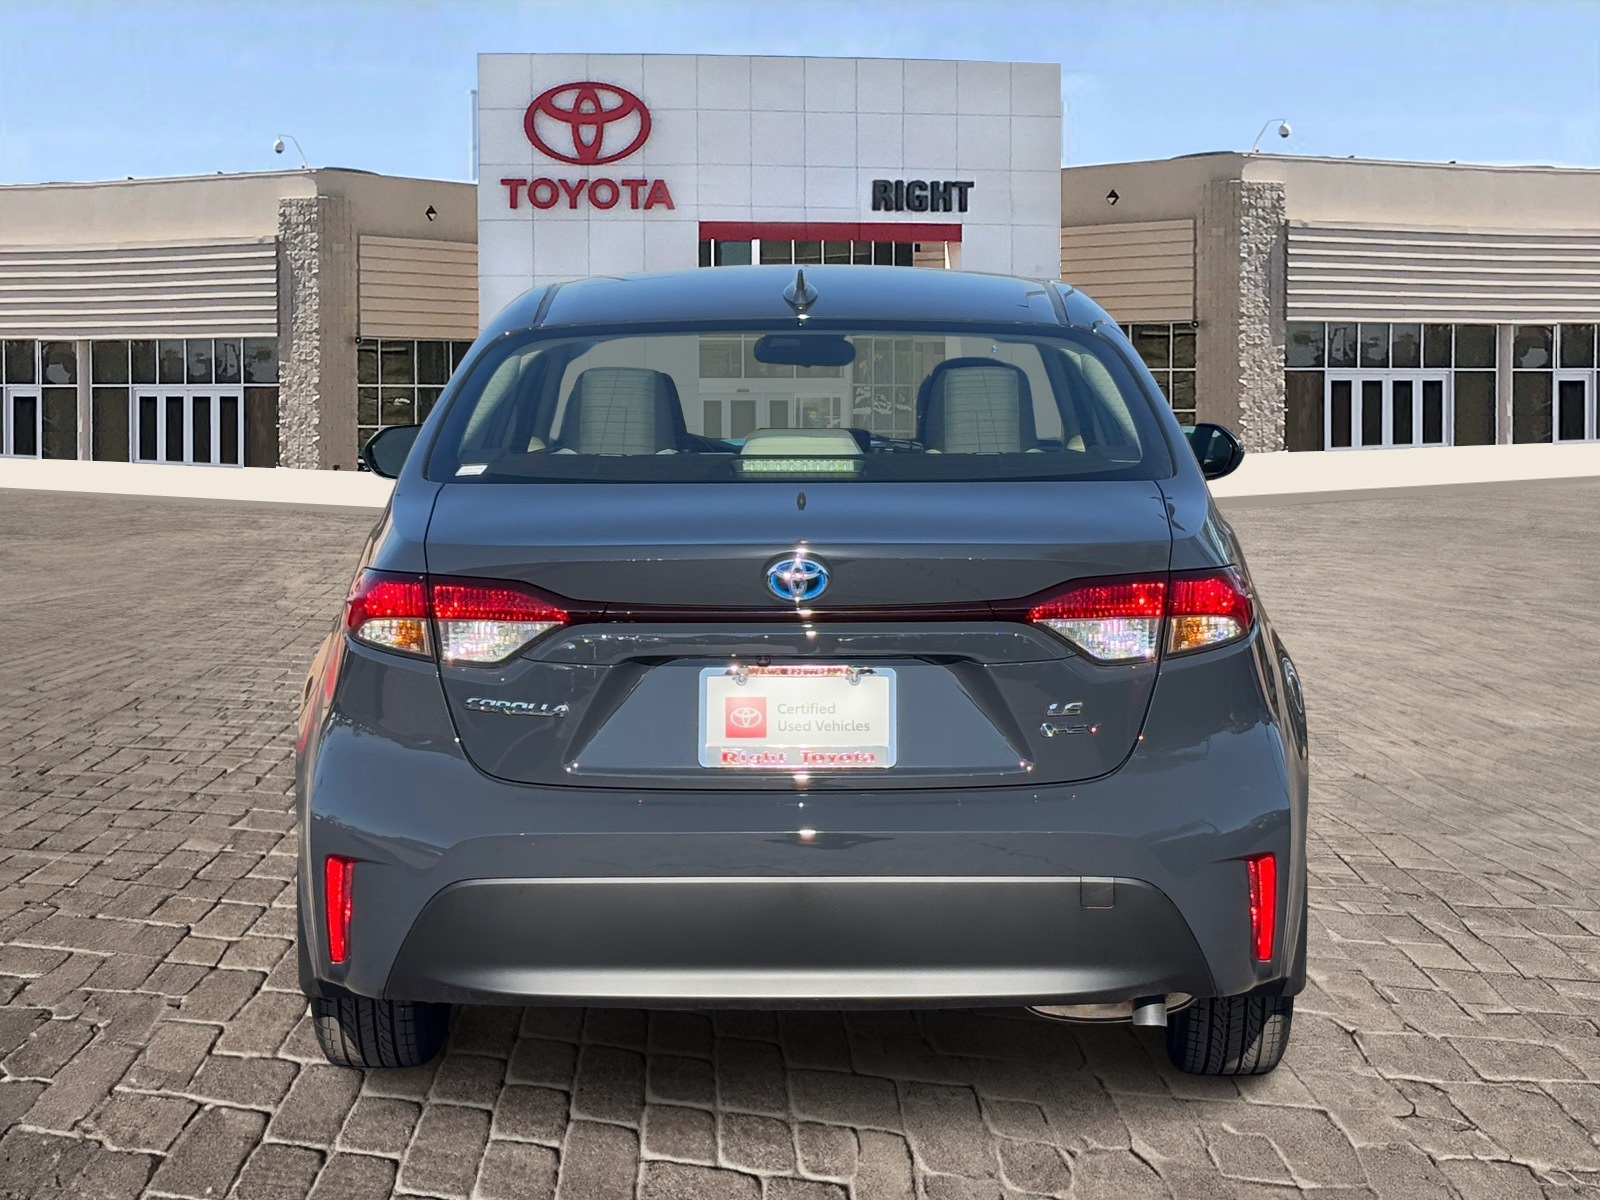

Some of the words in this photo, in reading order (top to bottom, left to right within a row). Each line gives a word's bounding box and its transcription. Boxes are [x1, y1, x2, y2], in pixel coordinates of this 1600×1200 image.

[501, 177, 675, 210] TOYOTA
[871, 179, 975, 213] RIGHT
[464, 697, 570, 718] COROLLA
[777, 703, 836, 715] Certified
[777, 720, 812, 732] Used
[815, 720, 870, 732] Vehicles
[721, 750, 788, 765] Right
[800, 750, 876, 765] Toyota
